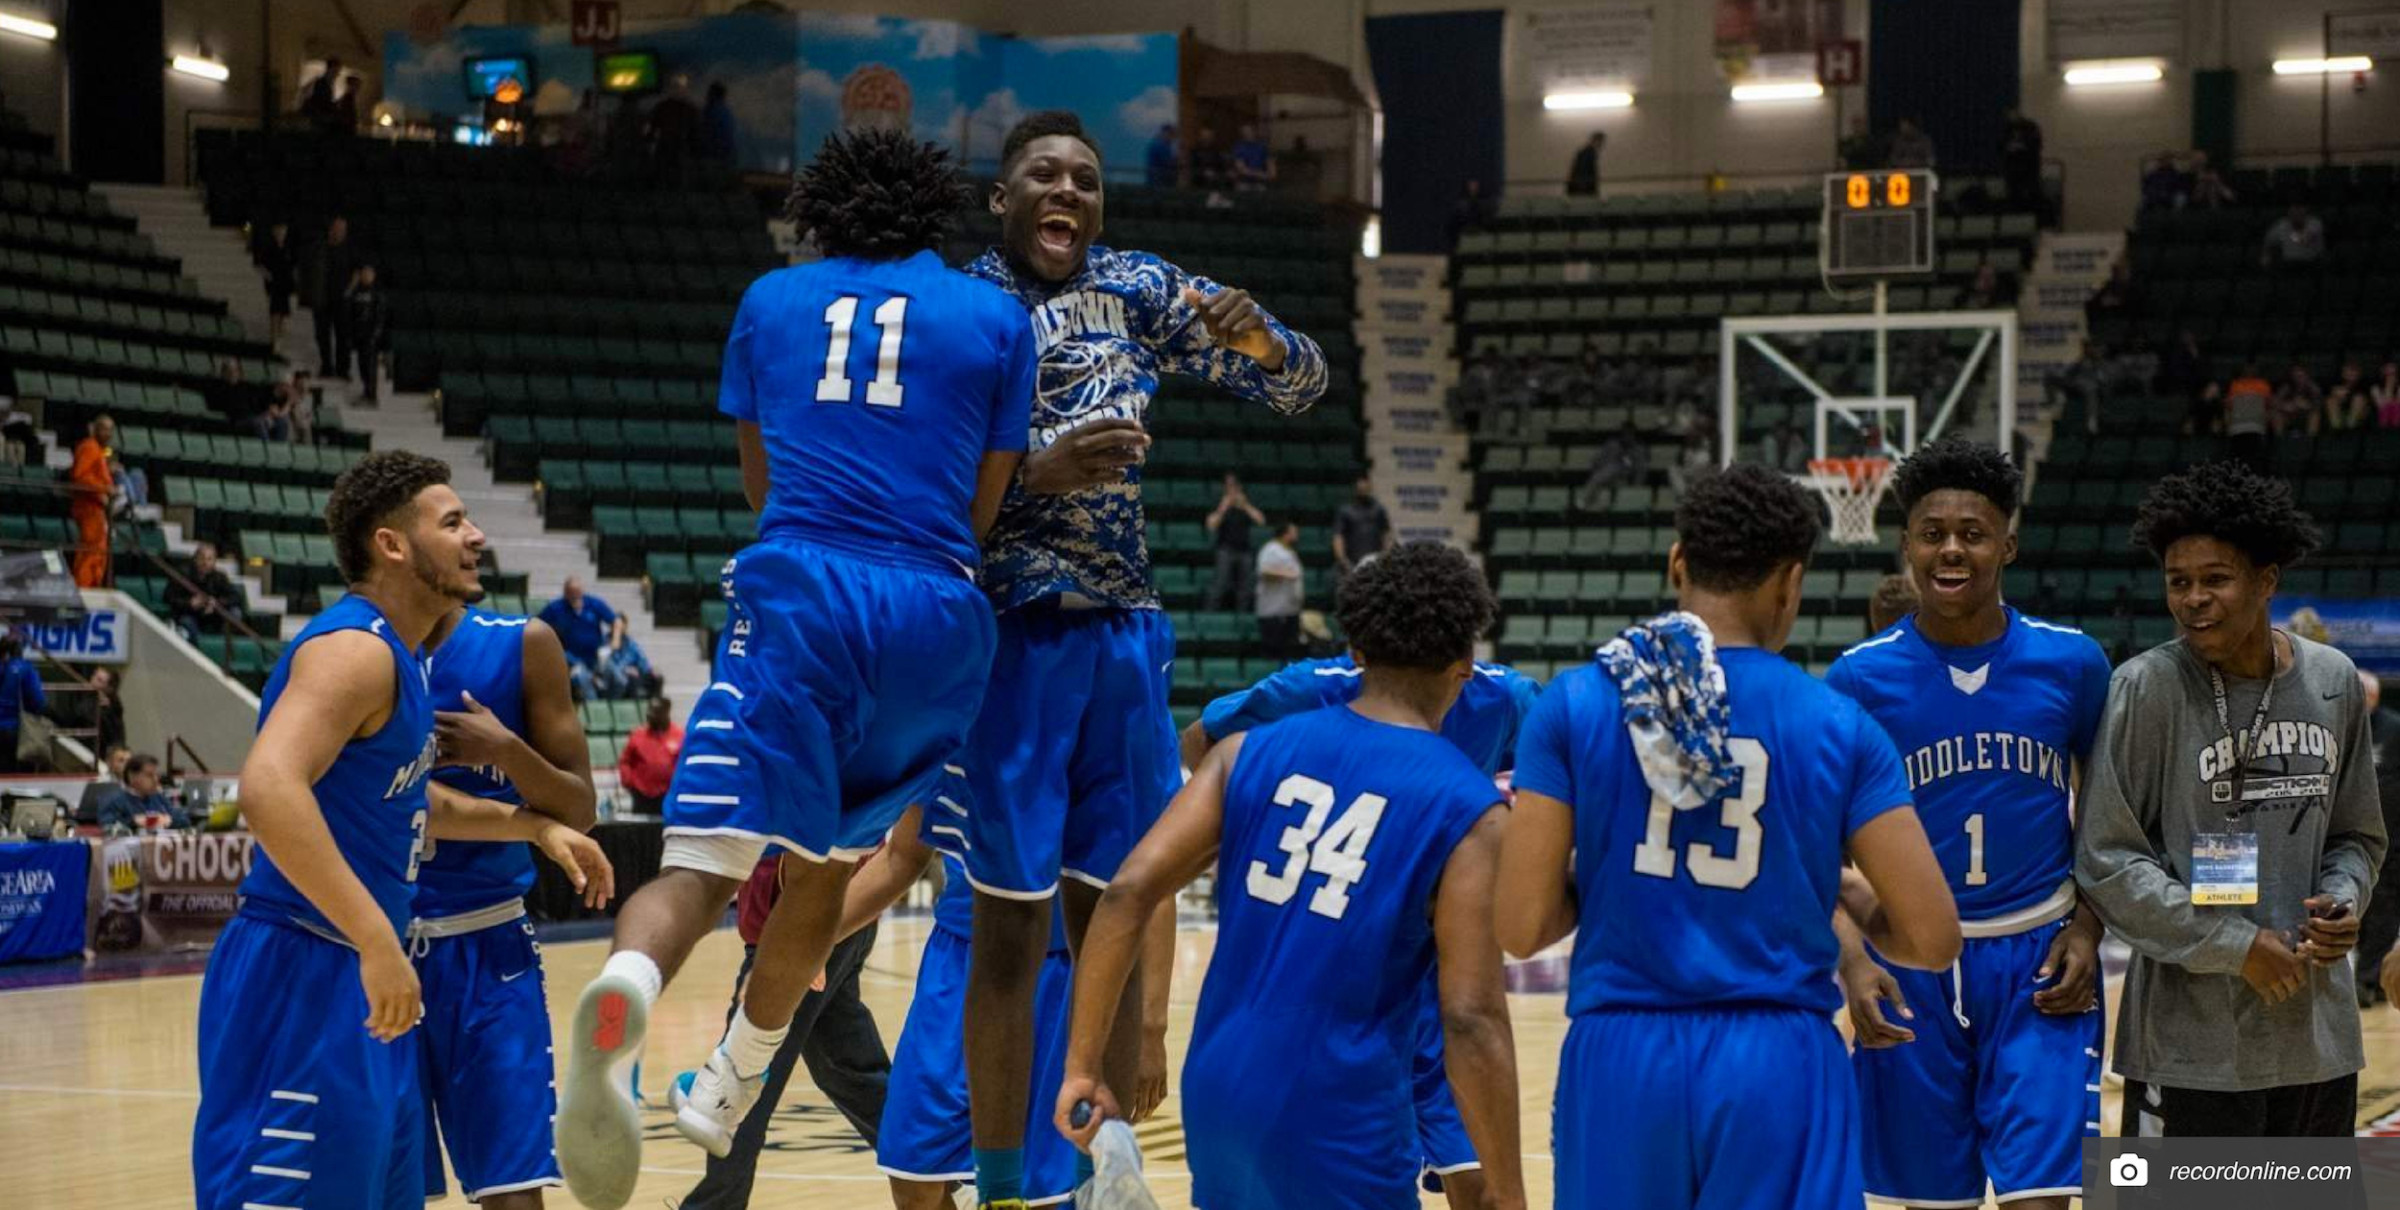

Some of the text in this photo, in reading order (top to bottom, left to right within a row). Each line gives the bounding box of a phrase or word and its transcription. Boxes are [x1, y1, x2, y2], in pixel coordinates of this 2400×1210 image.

[576, 5, 616, 40] JJ
[1825, 48, 1851, 82] H
[1846, 172, 1910, 208] 0 0
[815, 296, 908, 408] 11
[22, 611, 116, 654] IGNS
[1633, 737, 1770, 890] 13
[1246, 773, 1389, 920] 34
[1964, 813, 1988, 886] 1
[2206, 893, 2242, 901] ATHLETE
